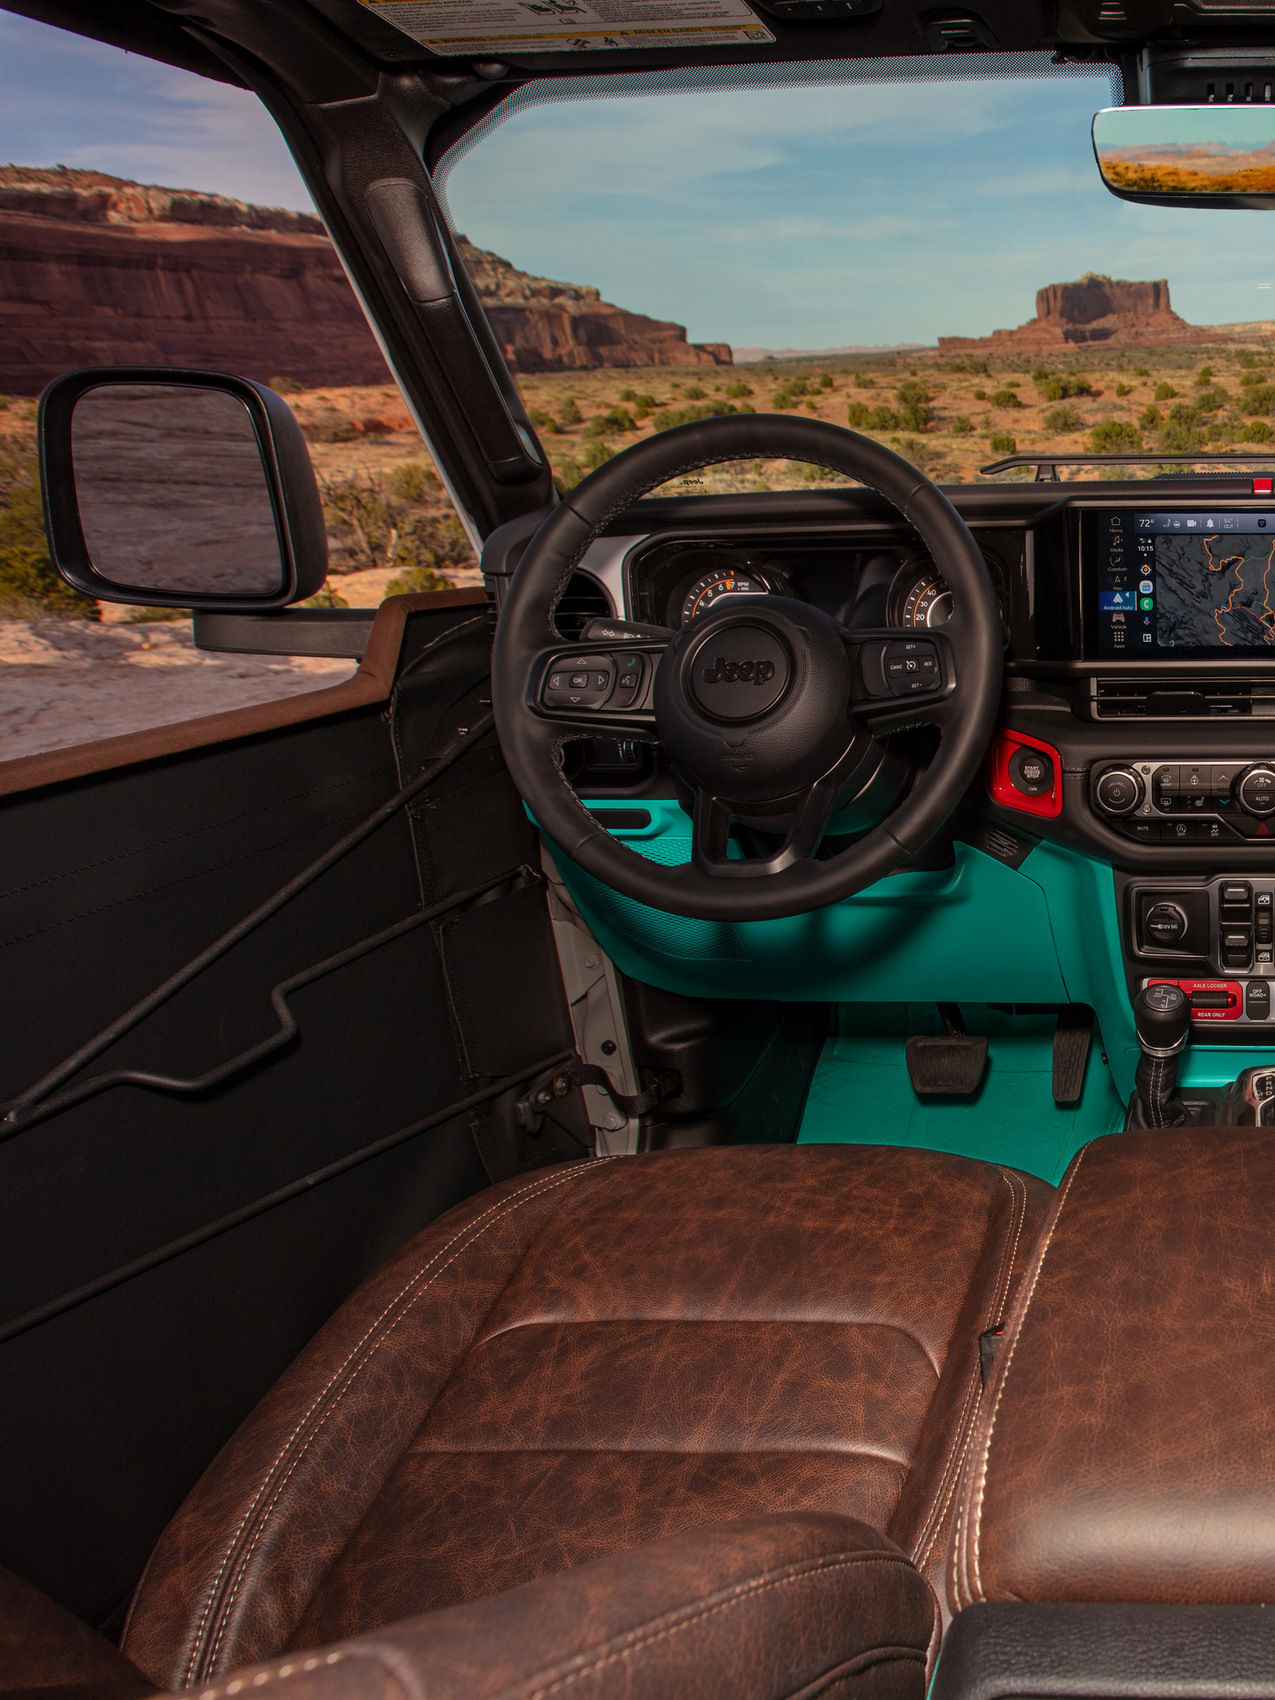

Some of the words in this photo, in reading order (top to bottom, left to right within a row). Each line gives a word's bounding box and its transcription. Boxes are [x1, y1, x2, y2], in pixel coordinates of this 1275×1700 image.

[730, 581, 736, 589] 7
[915, 613, 925, 621] 20
[702, 657, 775, 686] Jeep
